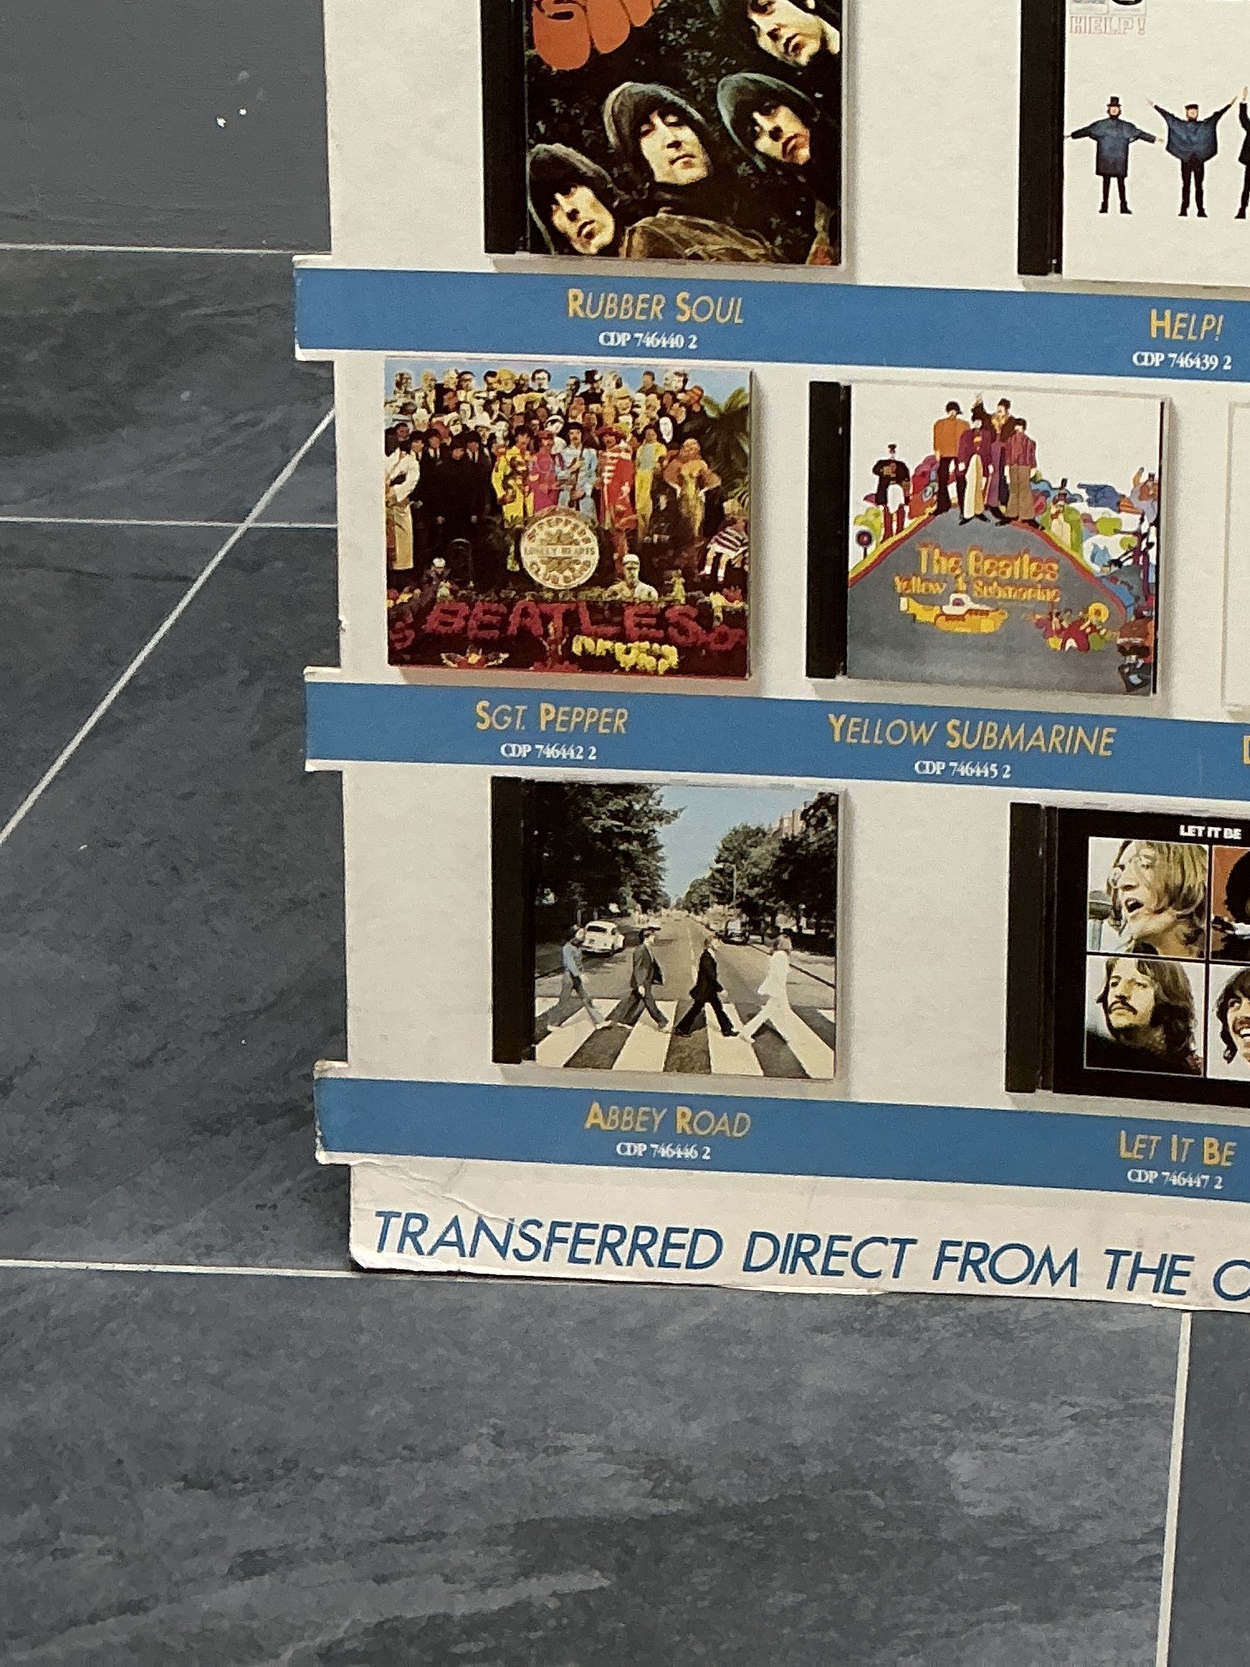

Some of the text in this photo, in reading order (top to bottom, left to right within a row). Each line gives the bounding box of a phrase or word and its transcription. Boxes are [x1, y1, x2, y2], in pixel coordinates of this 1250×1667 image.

[1070, 16, 1145, 35] HELP!
[566, 288, 745, 325] RUBBER SOUL
[1150, 308, 1224, 342] HELP!
[599, 332, 697, 349] CDP 746440 2
[1133, 352, 1232, 371] CDP 746439 2
[918, 543, 1060, 581] The Beatles
[540, 702, 628, 734] PEPPER
[827, 714, 1117, 756] YELLOW SUBMARINE
[501, 743, 531, 757] CDP
[588, 746, 596, 760] 2
[915, 761, 1011, 779] CDP 746445 2
[1180, 824, 1242, 840] LET IT BE
[584, 1102, 752, 1138] ABBEY ROAD
[616, 1143, 647, 1157] CDP
[702, 1147, 710, 1160] 2
[1119, 1130, 1237, 1166] LET IT BE
[1127, 1169, 1223, 1189] CDP 746447 2
[374, 1210, 723, 1271] TRANSFERRED
[743, 1232, 918, 1281] DIRECT
[932, 1239, 1079, 1288] FROM
[1103, 1249, 1195, 1296] THE
